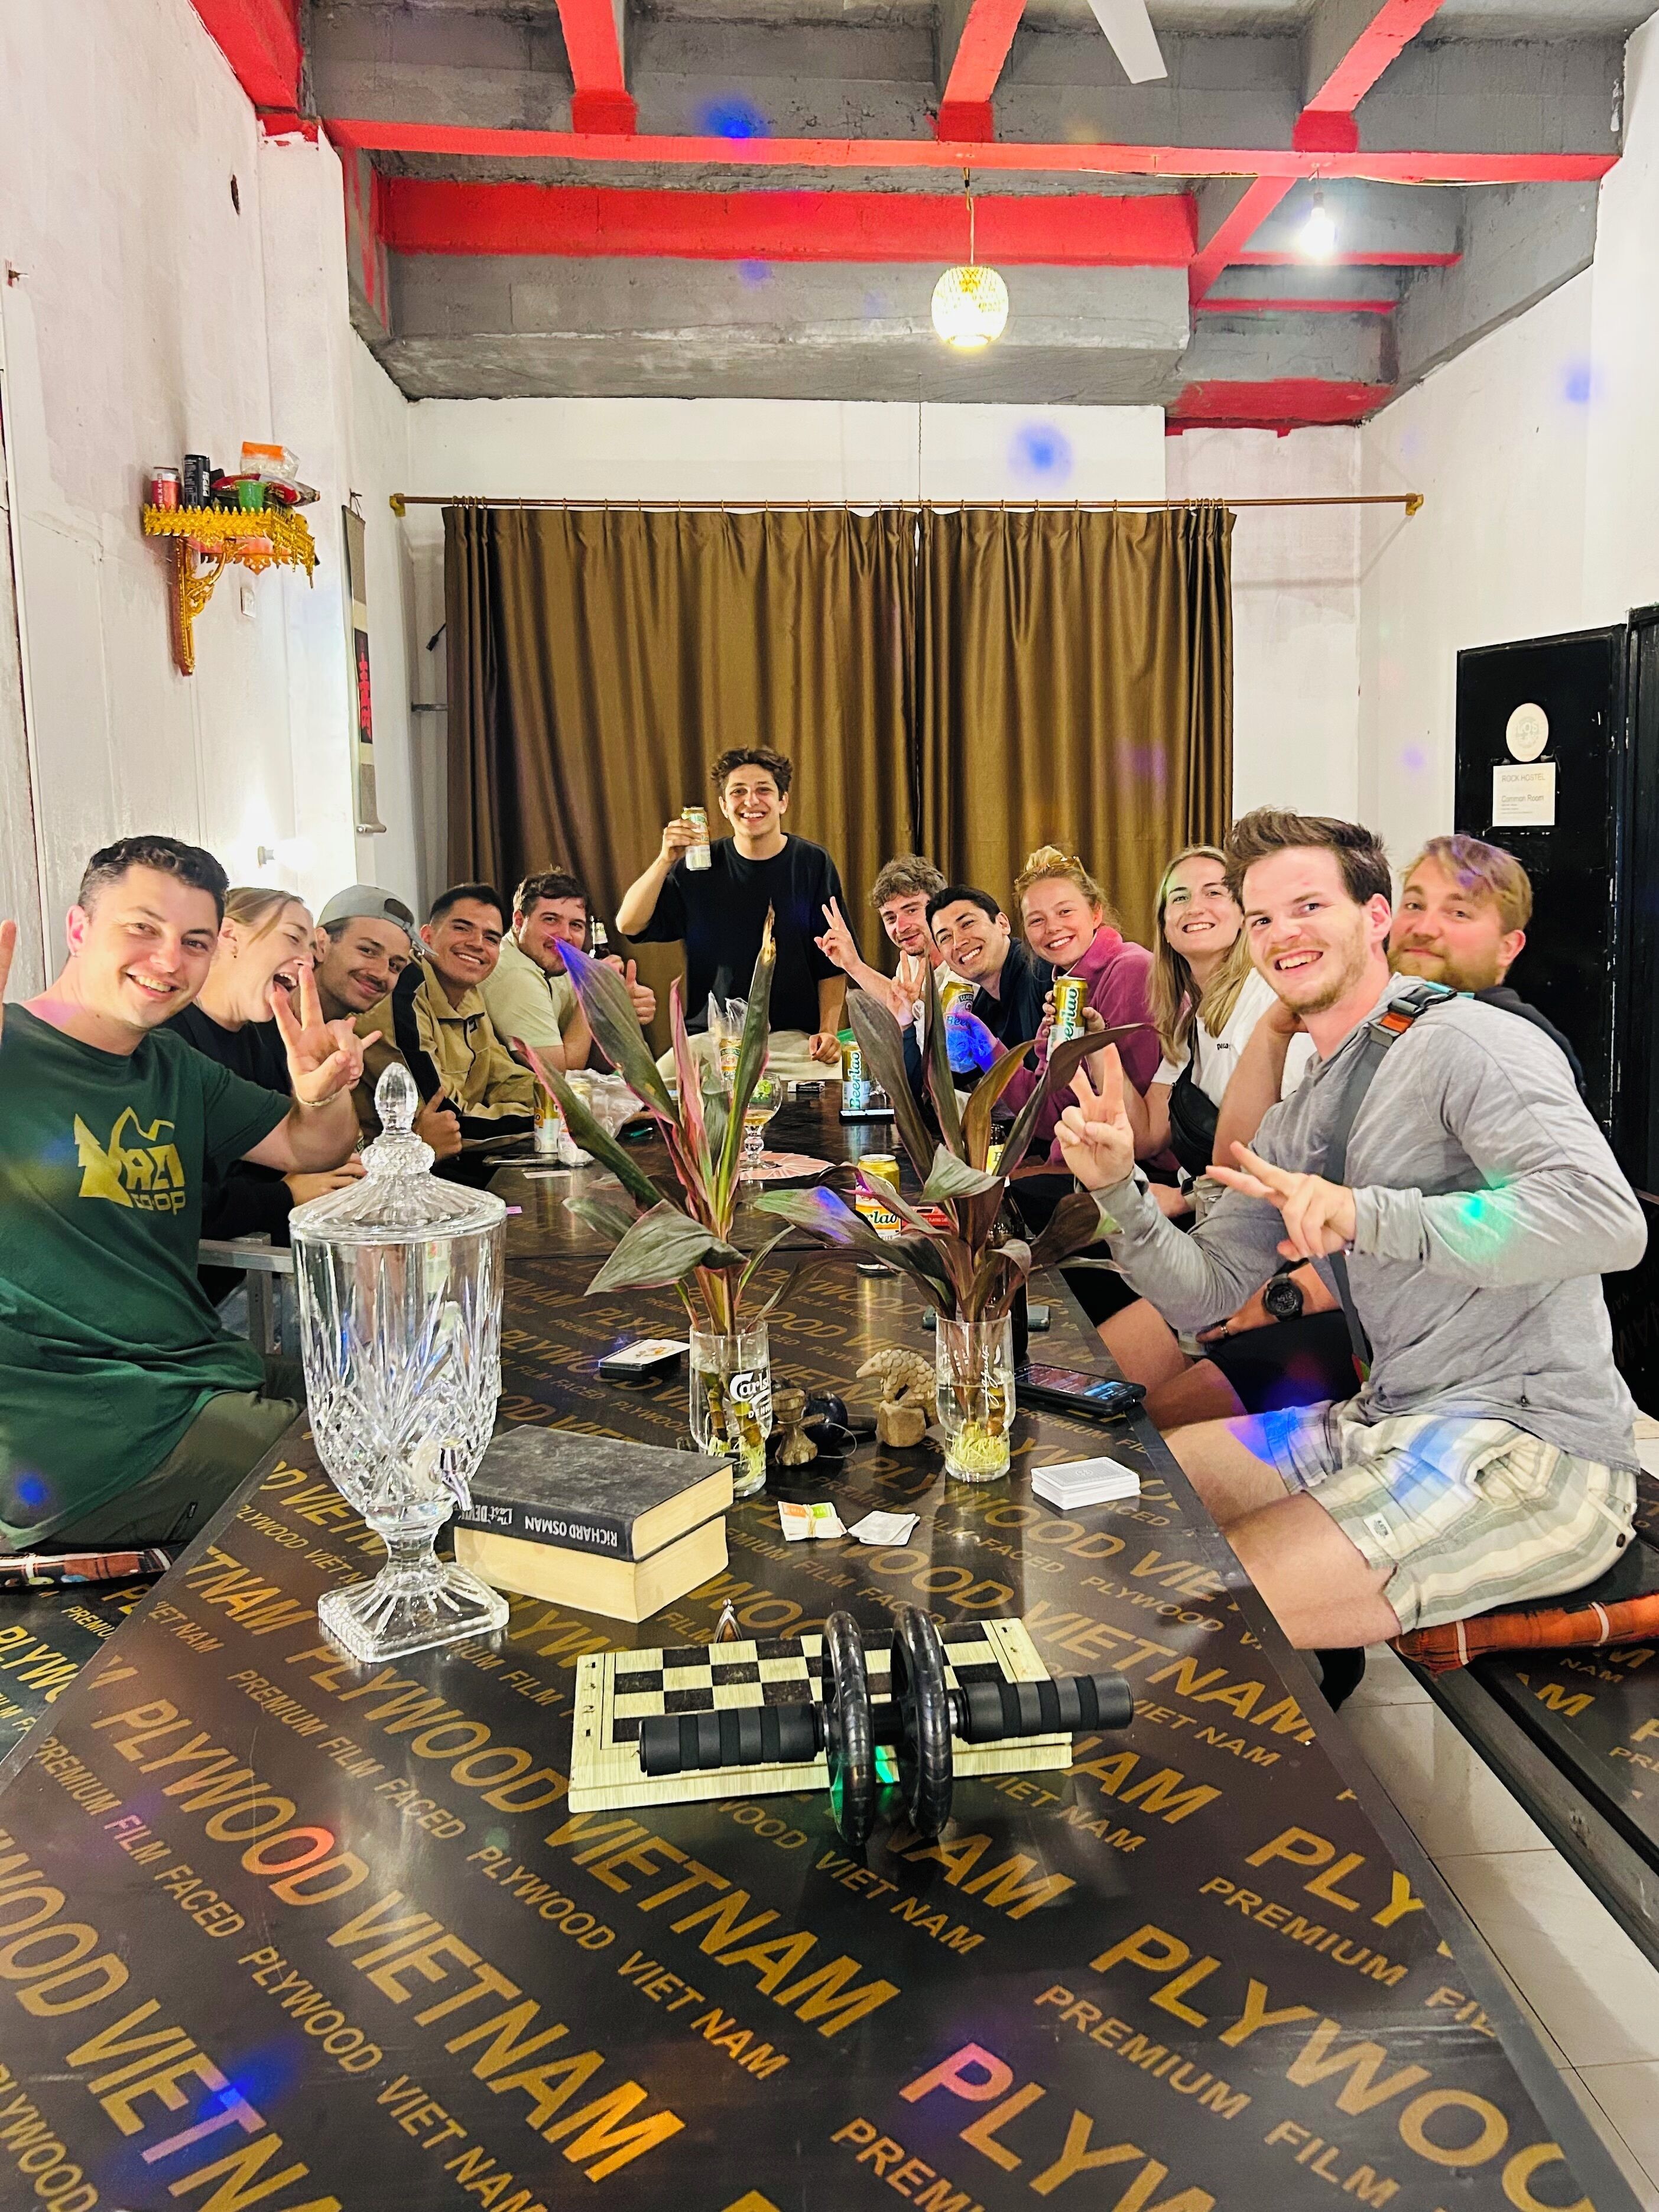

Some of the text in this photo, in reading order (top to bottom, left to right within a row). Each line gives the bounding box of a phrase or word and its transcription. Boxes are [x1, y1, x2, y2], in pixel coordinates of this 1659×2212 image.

[947, 1016, 969, 1027] Bee
[1061, 988, 1077, 1042] erlao
[849, 1052, 861, 1110] Beerlao
[865, 1210, 897, 1224] rlao
[550, 1379, 606, 1400] FACED
[730, 1369, 770, 1402] Carls
[524, 1515, 567, 1537] OSMAN
[304, 1548, 353, 1574] VIET
[792, 1560, 856, 1588] FILM
[977, 1538, 1065, 1573] FACED
[1081, 1575, 1225, 1632] PLYWOOD
[170, 1622, 225, 1654] NAM
[499, 1669, 566, 1707] FILM
[1193, 1725, 1283, 1767] NAM
[285, 1643, 569, 1813] PLYWOOD
[544, 1812, 901, 2038] VIETNAM
[1056, 1805, 1147, 1853] NAM
[1198, 1876, 1409, 1986] PREMIUM
[90, 1698, 686, 2183] PLYWOOD VIETNAM
[226, 1669, 986, 2212] PREMIUM FILM FACED PLYWOOD VIET NAM PREM
[103, 1814, 171, 1866] FILM
[154, 1864, 246, 1938] FACED
[238, 1946, 384, 2073] PLYWOOD
[376, 2074, 467, 2149] VIET
[815, 1850, 899, 1899] VIET
[890, 1897, 986, 1954] NAM
[1034, 1983, 1252, 2120] PREMIUM
[1264, 2119, 1401, 2209] FILM
